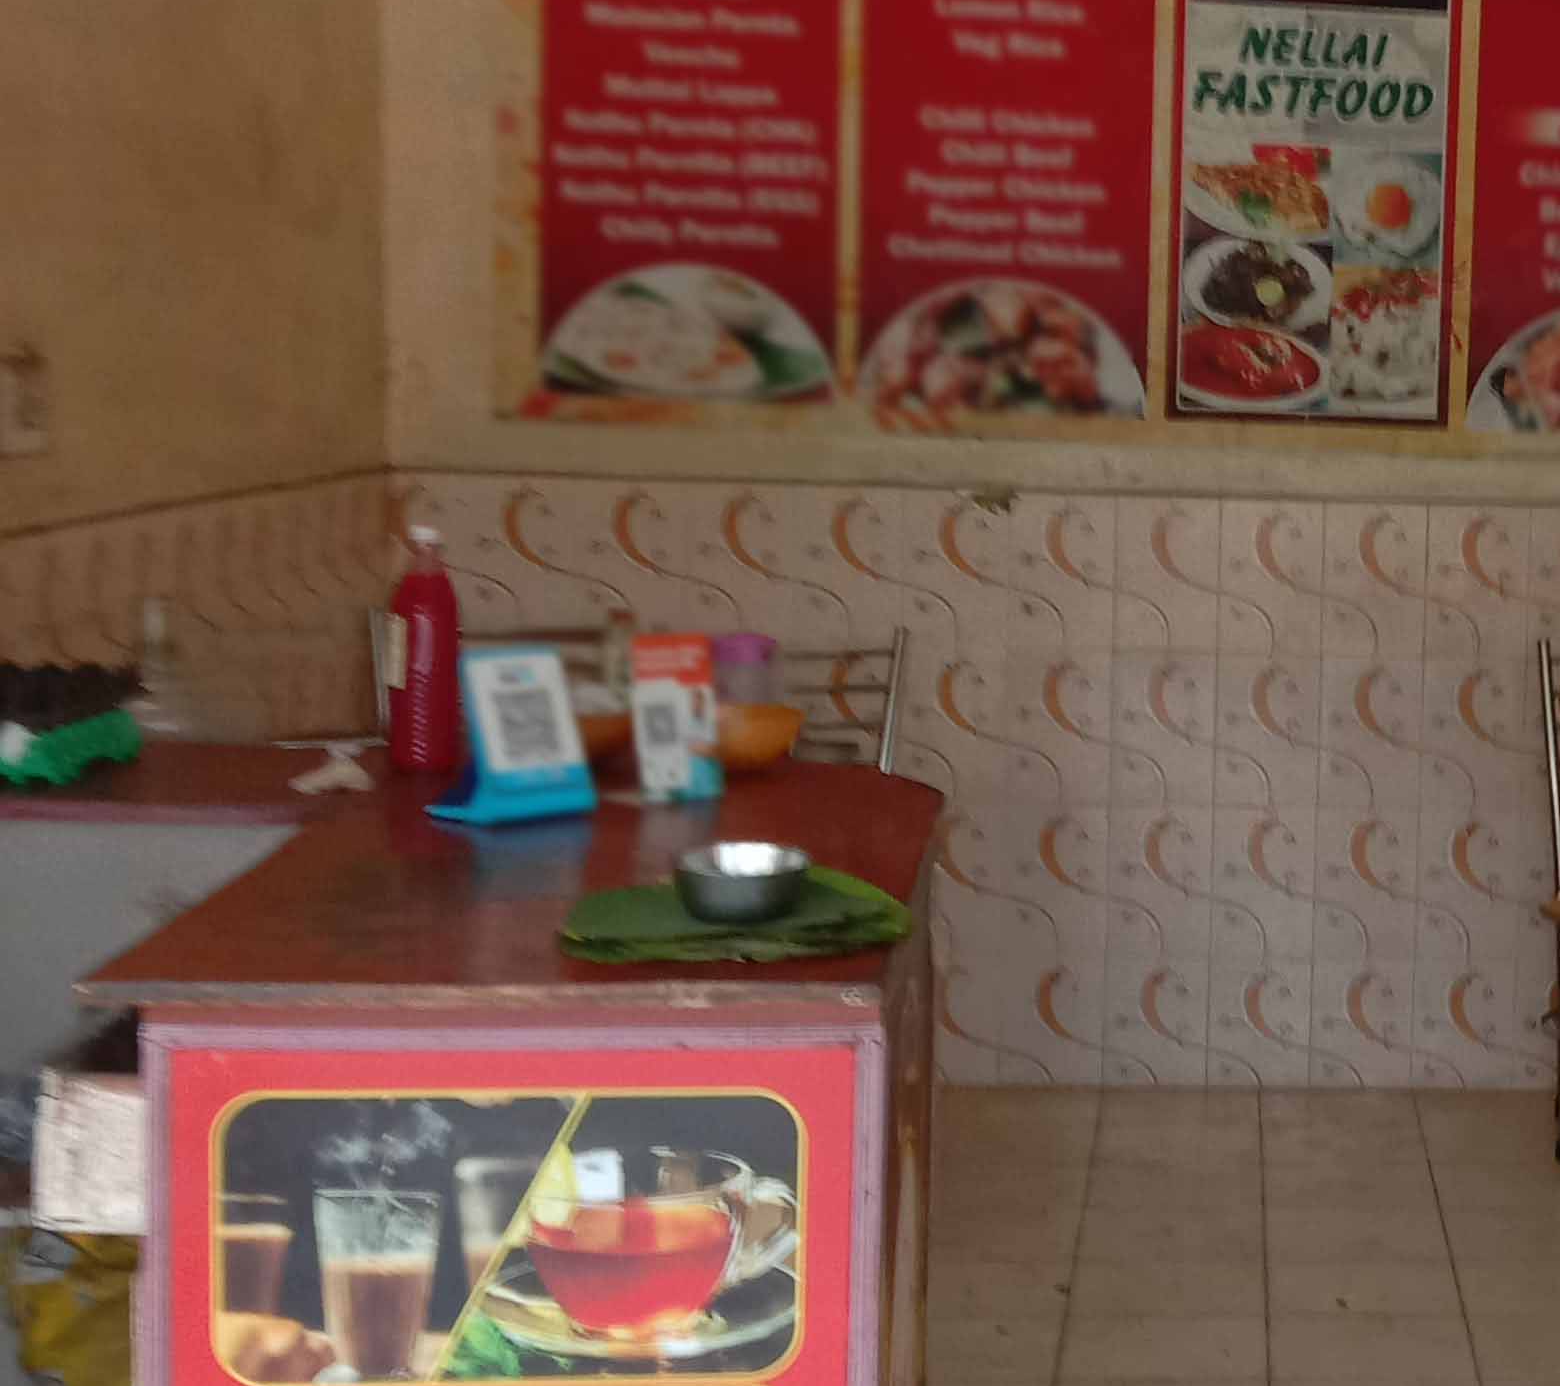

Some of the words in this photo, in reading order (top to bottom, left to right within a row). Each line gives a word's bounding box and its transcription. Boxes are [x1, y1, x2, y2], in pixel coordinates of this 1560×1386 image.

[1007, 31, 1067, 60] Rice
[1240, 26, 1389, 68] NELLAI
[1193, 69, 1434, 120] FASTFOOD
